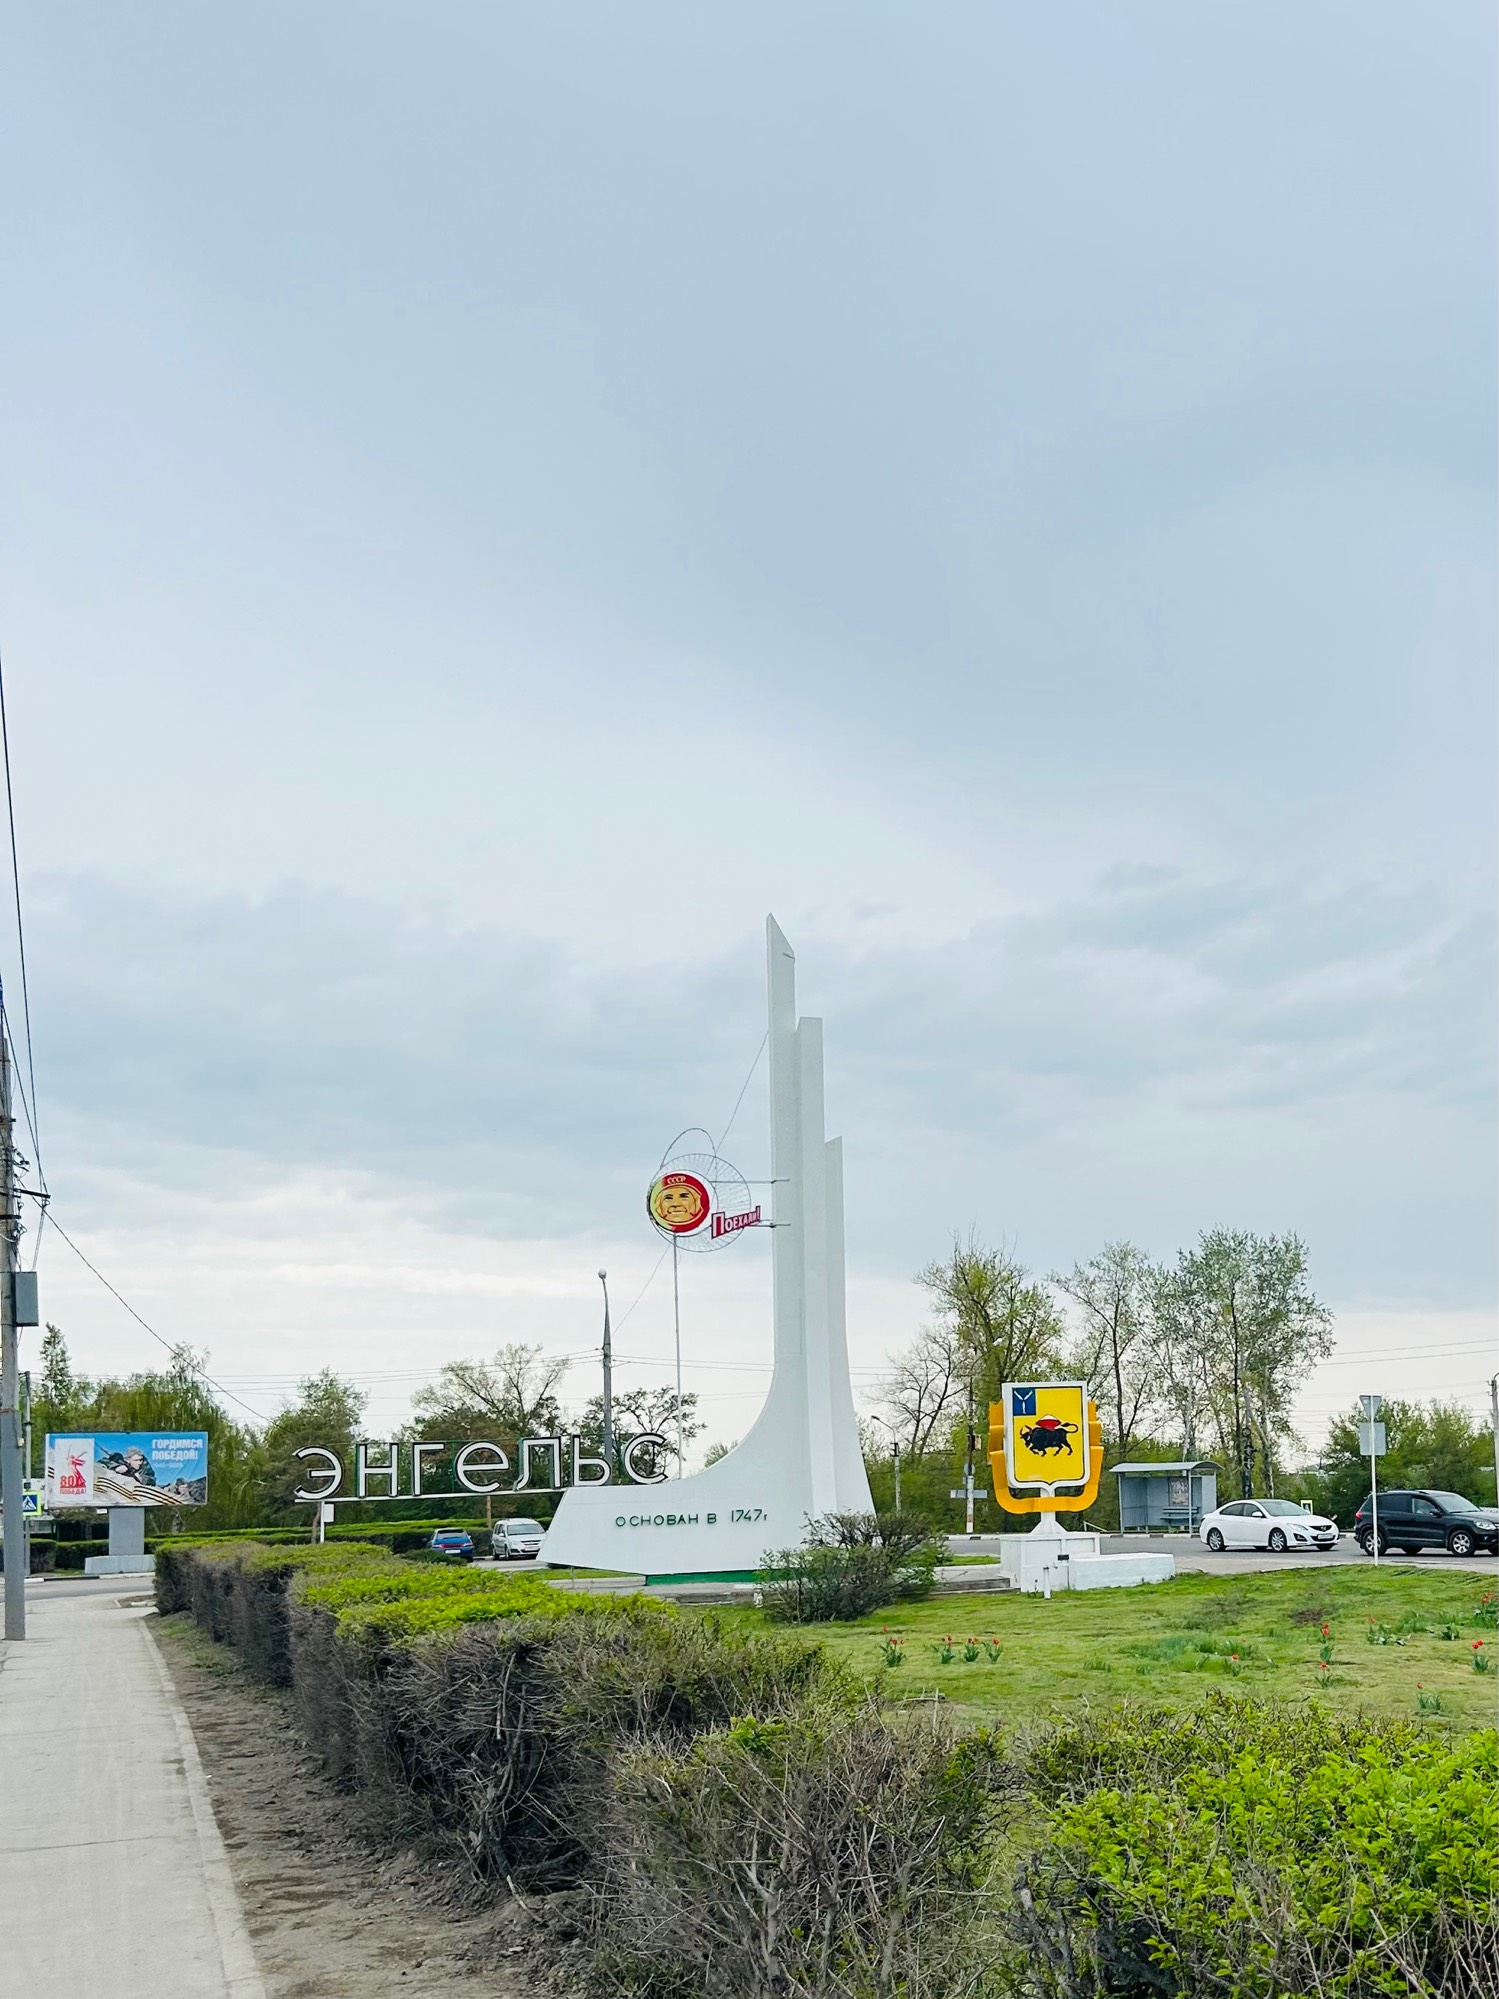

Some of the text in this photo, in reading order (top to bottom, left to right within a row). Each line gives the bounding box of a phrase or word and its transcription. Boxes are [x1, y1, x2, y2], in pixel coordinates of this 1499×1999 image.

[667, 1175, 686, 1185] СССР
[152, 1439, 203, 1450] ГОРДИМСЯ
[152, 1449, 198, 1461] ПОБЕДОЙ!
[615, 1513, 699, 1527] ОСНОВАН
[707, 1512, 717, 1524] В
